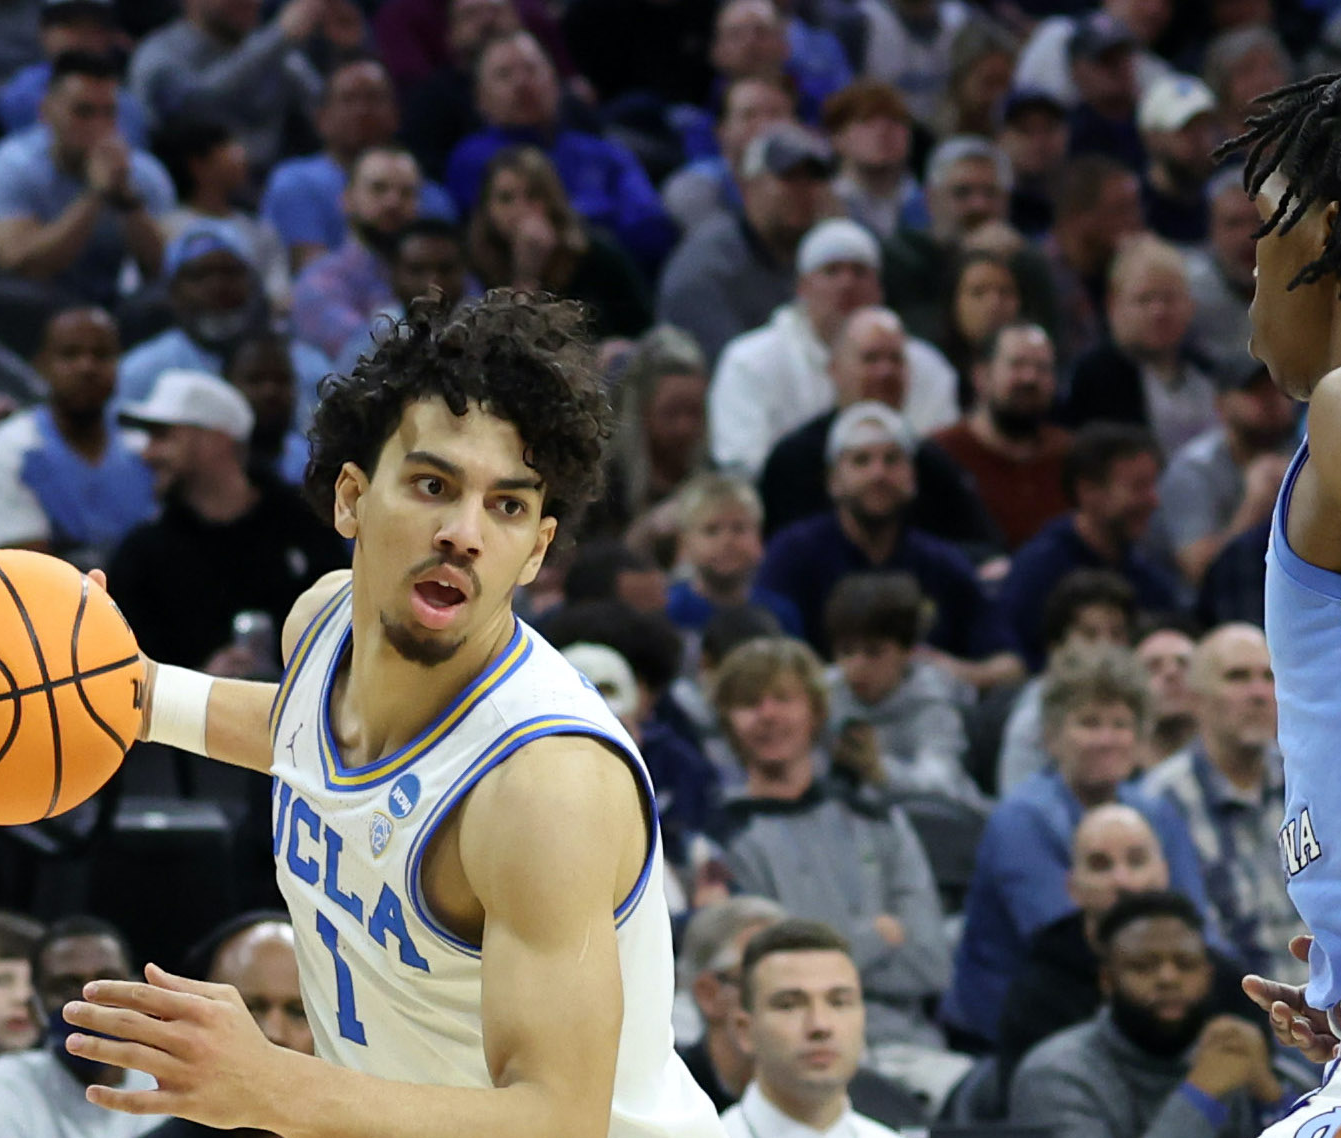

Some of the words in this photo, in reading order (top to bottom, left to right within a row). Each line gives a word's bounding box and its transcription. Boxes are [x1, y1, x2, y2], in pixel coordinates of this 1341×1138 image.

[273, 775, 431, 974] UCLA
[1279, 807, 1322, 877] NA
[316, 909, 368, 1046] 1
